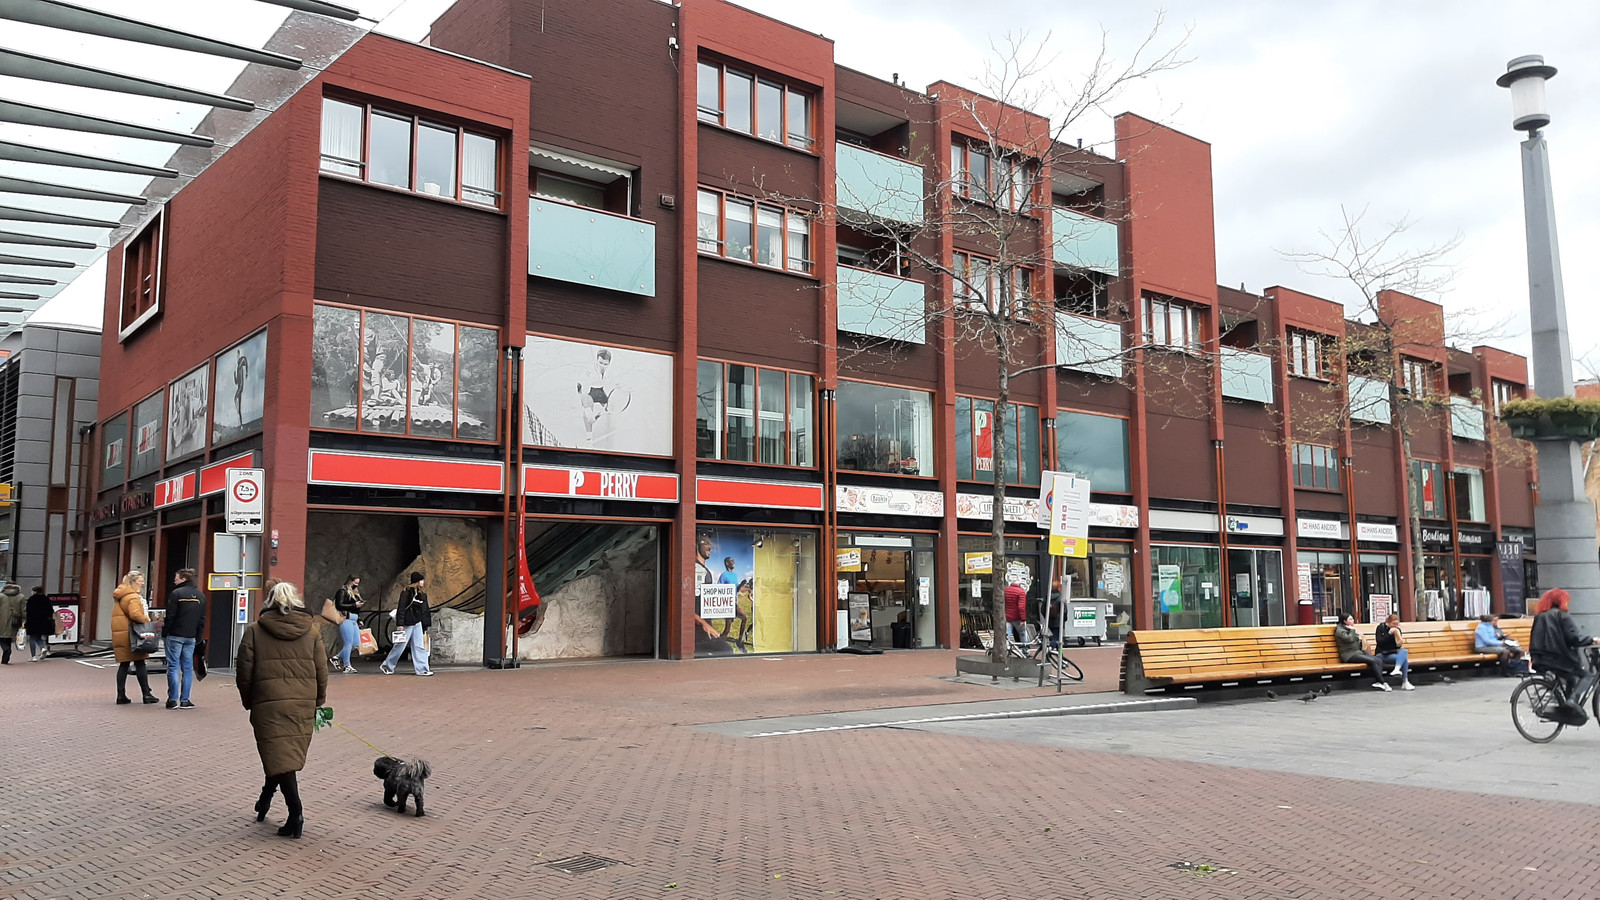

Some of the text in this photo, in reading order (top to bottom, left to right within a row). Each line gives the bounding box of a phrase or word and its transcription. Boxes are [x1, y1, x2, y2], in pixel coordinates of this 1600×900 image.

[601, 472, 639, 498] PERRY
[1321, 523, 1338, 531] ANDERS
[1367, 526, 1393, 535] HANS ANDERS
[703, 587, 734, 595] SHOP NU DE
[704, 597, 734, 607] NIEUWE
